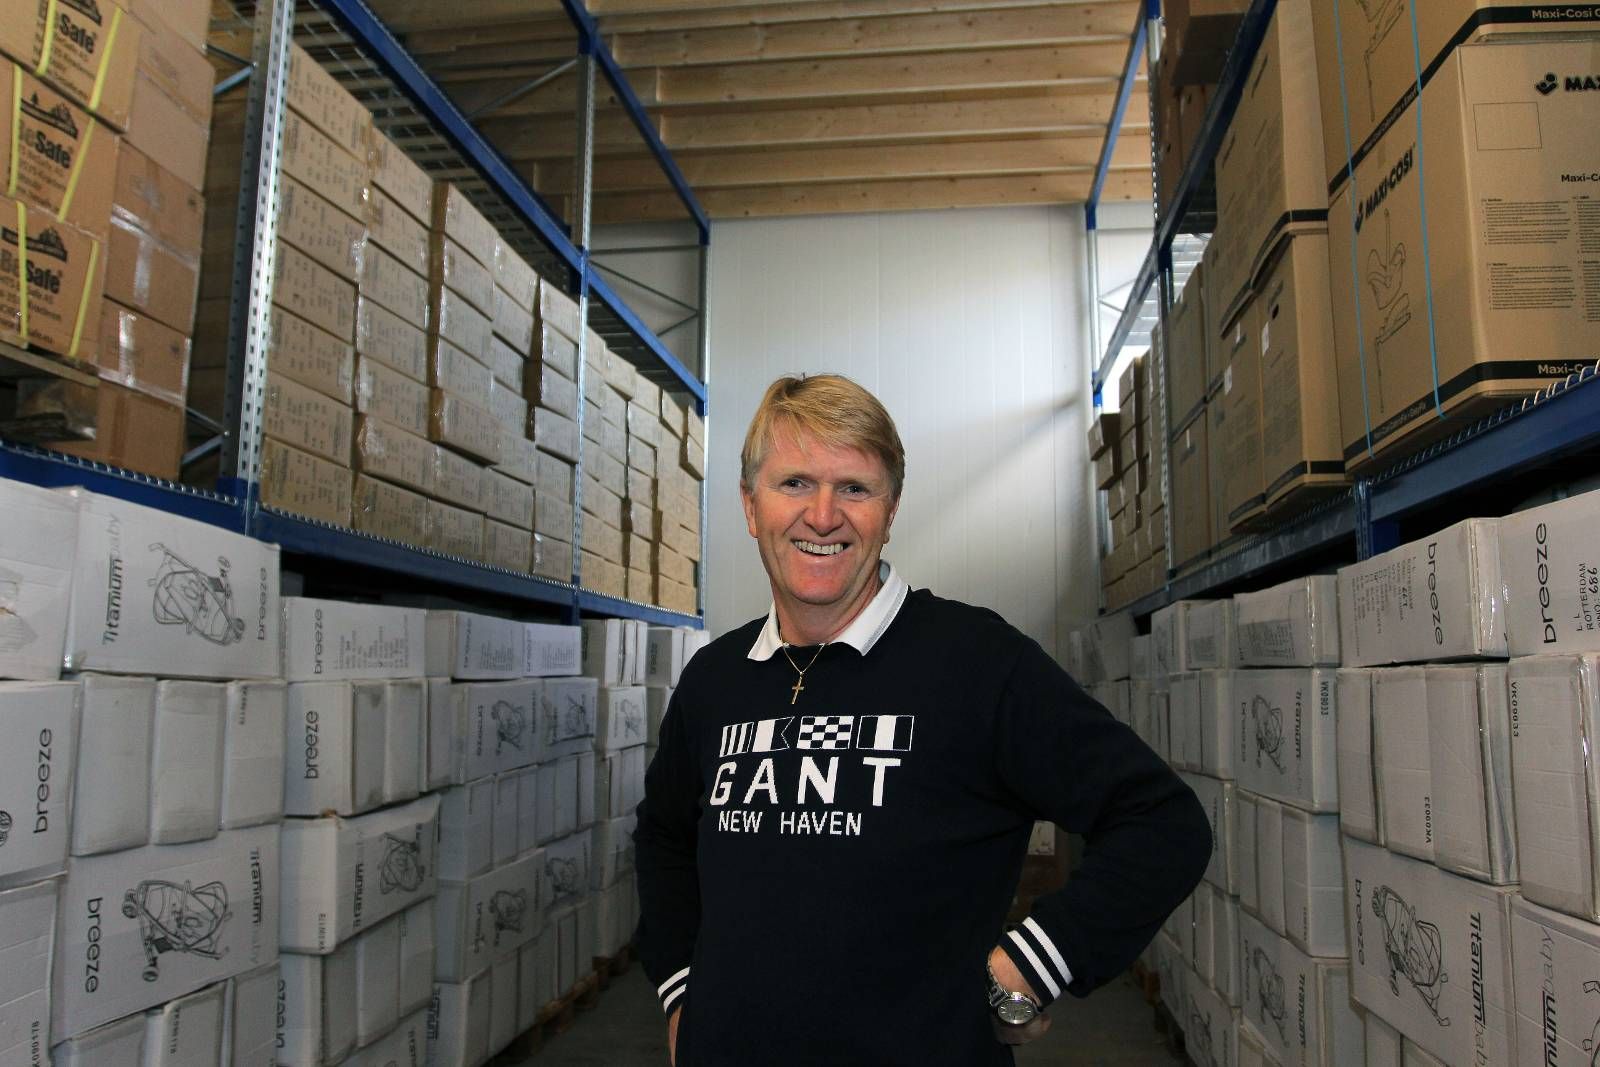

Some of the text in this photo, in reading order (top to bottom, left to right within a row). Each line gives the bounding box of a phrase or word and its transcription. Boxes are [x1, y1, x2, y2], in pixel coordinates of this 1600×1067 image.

[1532, 8, 1592, 19] Maxi-Cosi
[1561, 173, 1600, 182] Maxi-C
[1538, 363, 1584, 374] Maxi-C
[256, 565, 268, 640] breeze
[1428, 543, 1443, 646] breeze
[1535, 523, 1557, 643] breeze
[1578, 562, 1594, 632] ROTTERDAM
[312, 607, 323, 674] breeze
[304, 709, 319, 779] breeze
[33, 727, 52, 834] breeze
[710, 757, 901, 807] GANT
[718, 810, 862, 837] NEW HAVEN
[86, 897, 104, 993] breeze
[1355, 879, 1366, 966] breeze
